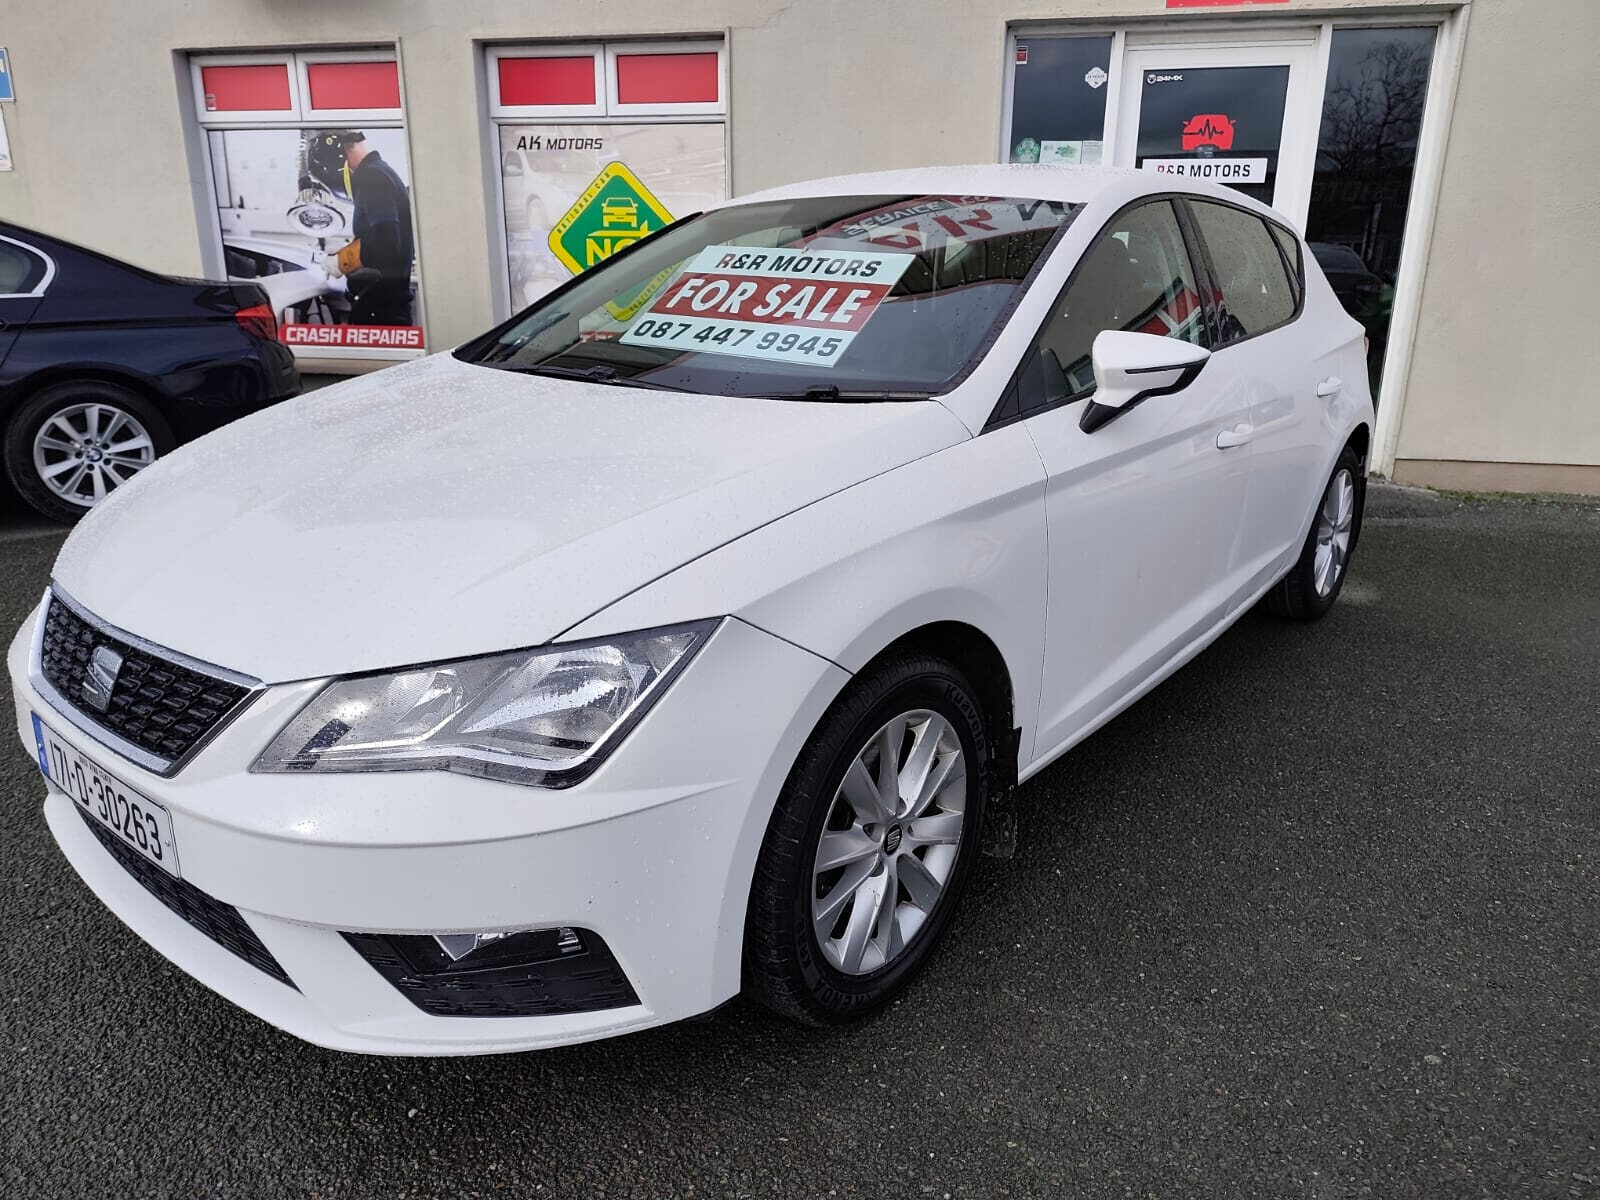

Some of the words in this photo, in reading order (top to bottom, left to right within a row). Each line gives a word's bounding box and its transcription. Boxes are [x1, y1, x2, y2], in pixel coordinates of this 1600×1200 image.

[516, 135, 541, 150] AK
[546, 138, 604, 150] MOTORS
[1189, 164, 1251, 177] MOTORS
[715, 252, 762, 271] R&R
[767, 255, 882, 278] MOTORS
[665, 278, 758, 314] FOR
[752, 282, 872, 325] SALE
[285, 326, 343, 343] CRASH
[346, 328, 420, 345] REPAIRS
[633, 319, 692, 340] 087
[692, 325, 755, 348] 447
[755, 331, 843, 358] 9945
[49, 738, 163, 862] 171-D-30263
